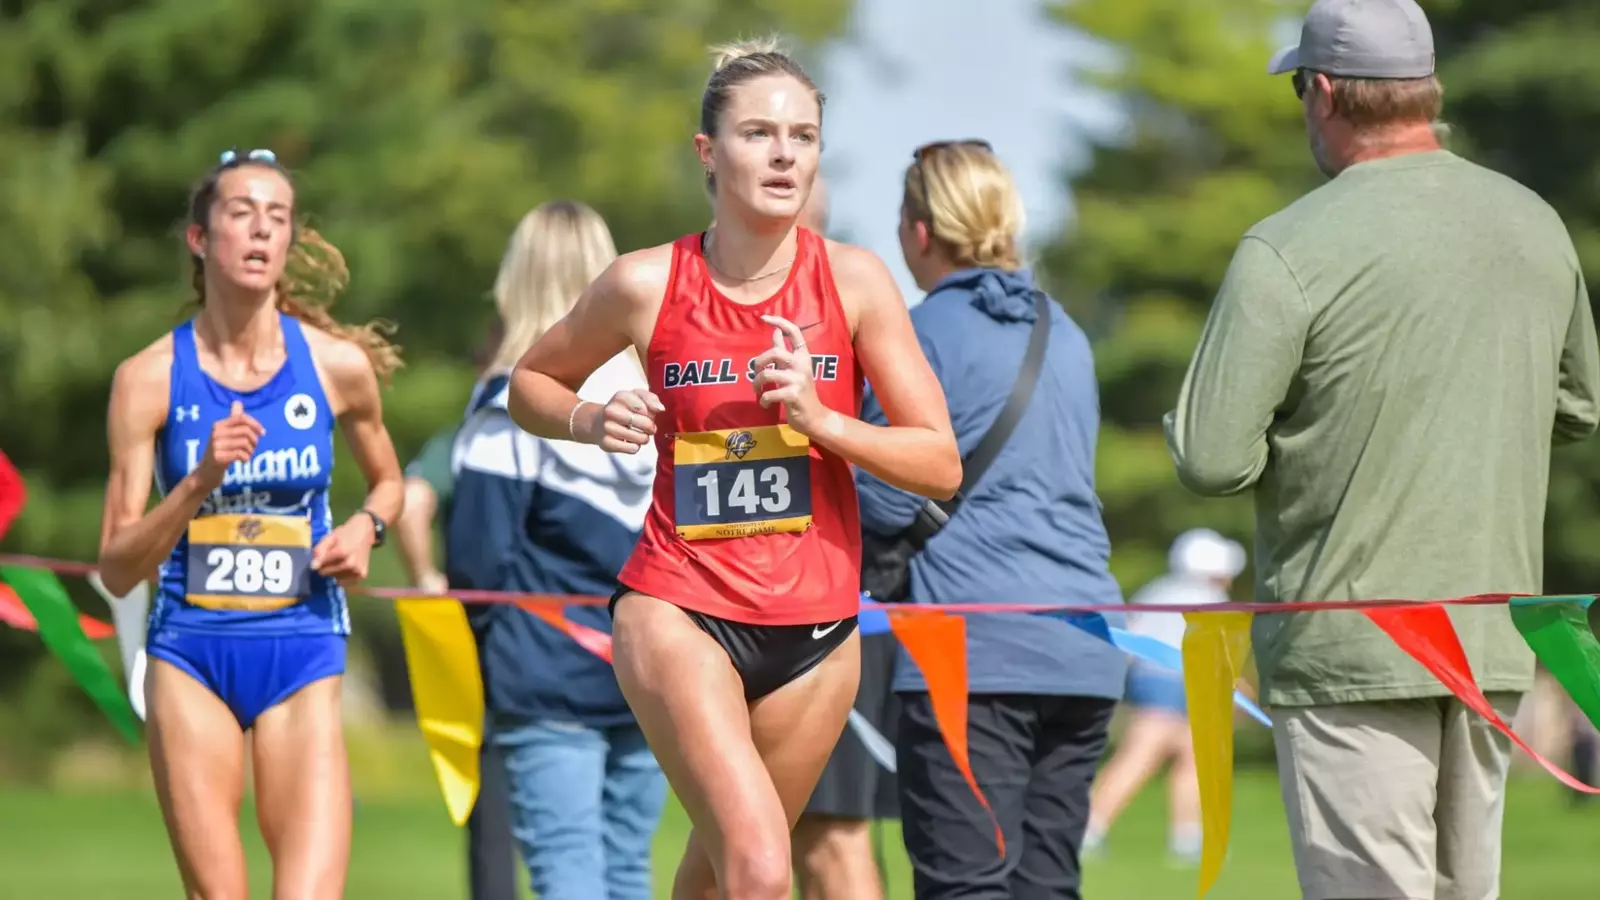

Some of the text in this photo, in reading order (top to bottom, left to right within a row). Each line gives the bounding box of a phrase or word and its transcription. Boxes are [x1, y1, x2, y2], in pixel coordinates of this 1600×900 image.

[664, 354, 839, 389] BALL STE
[185, 438, 321, 485] Iiana
[697, 466, 791, 516] 143
[750, 526, 777, 535] DAME
[205, 547, 293, 594] 289
